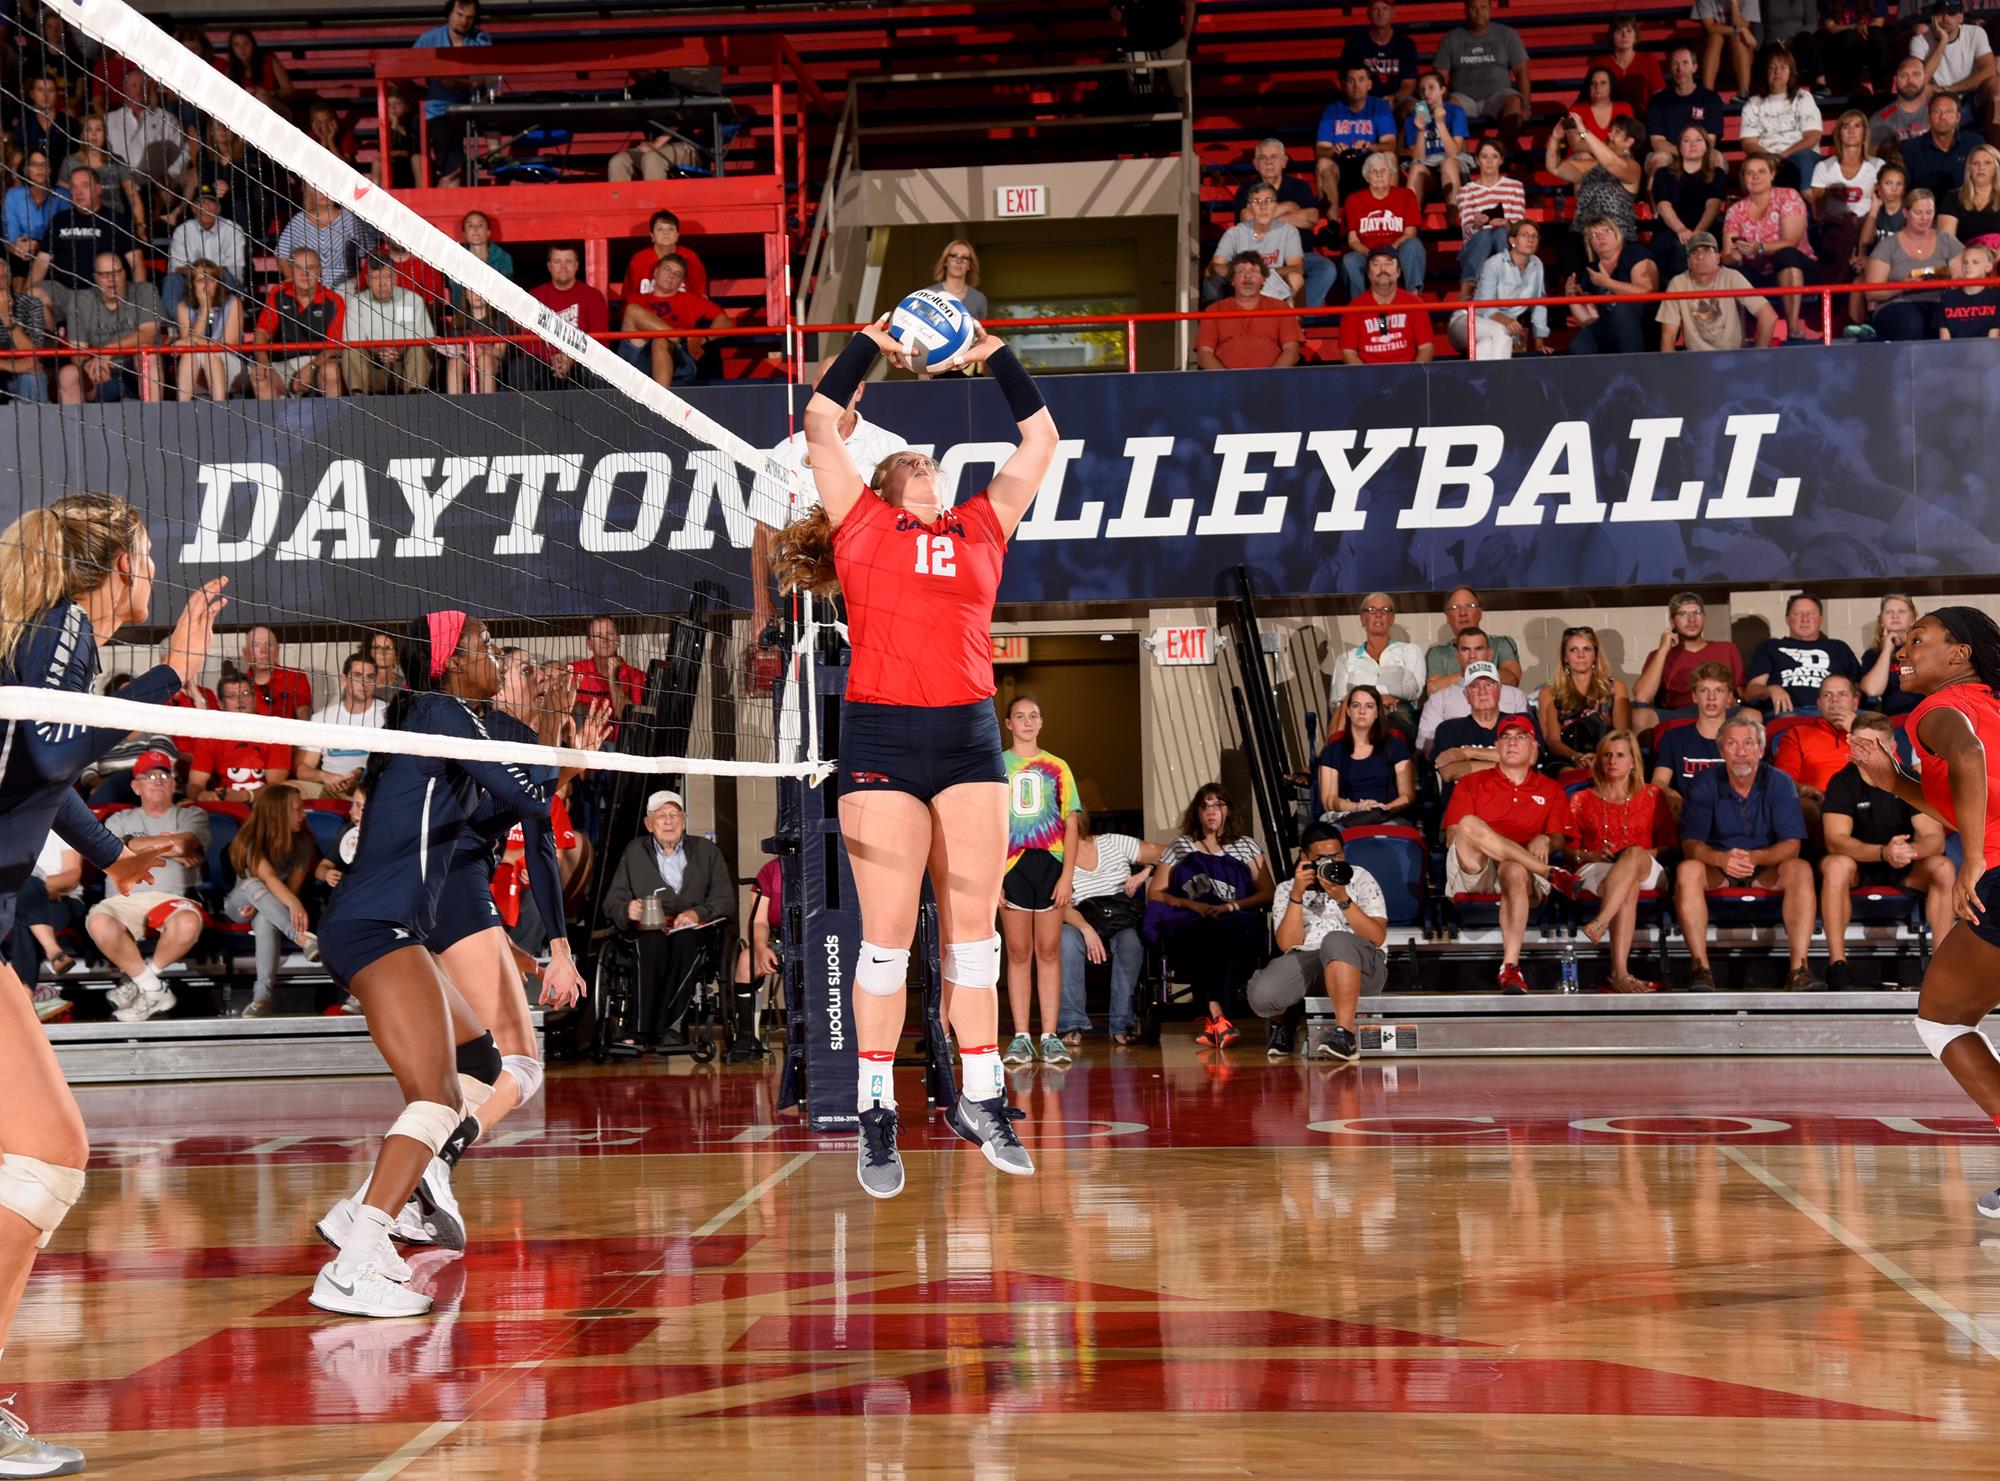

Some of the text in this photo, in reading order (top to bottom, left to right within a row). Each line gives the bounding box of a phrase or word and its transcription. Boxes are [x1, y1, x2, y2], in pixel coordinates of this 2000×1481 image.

[1007, 188, 1037, 212] EXIT
[1359, 214, 1404, 233] DAYTON
[914, 291, 955, 319] molten
[1944, 304, 1996, 319] DAYTON
[179, 412, 1801, 563] DAYTON OLLEYBALL
[914, 533, 956, 577] 12
[1167, 628, 1206, 659] EXIT
[1781, 667, 1830, 680] DAYTO
[1781, 676, 1824, 688] FLYE
[824, 935, 845, 1051] sports imports
[817, 1115, 833, 1123] (800)
